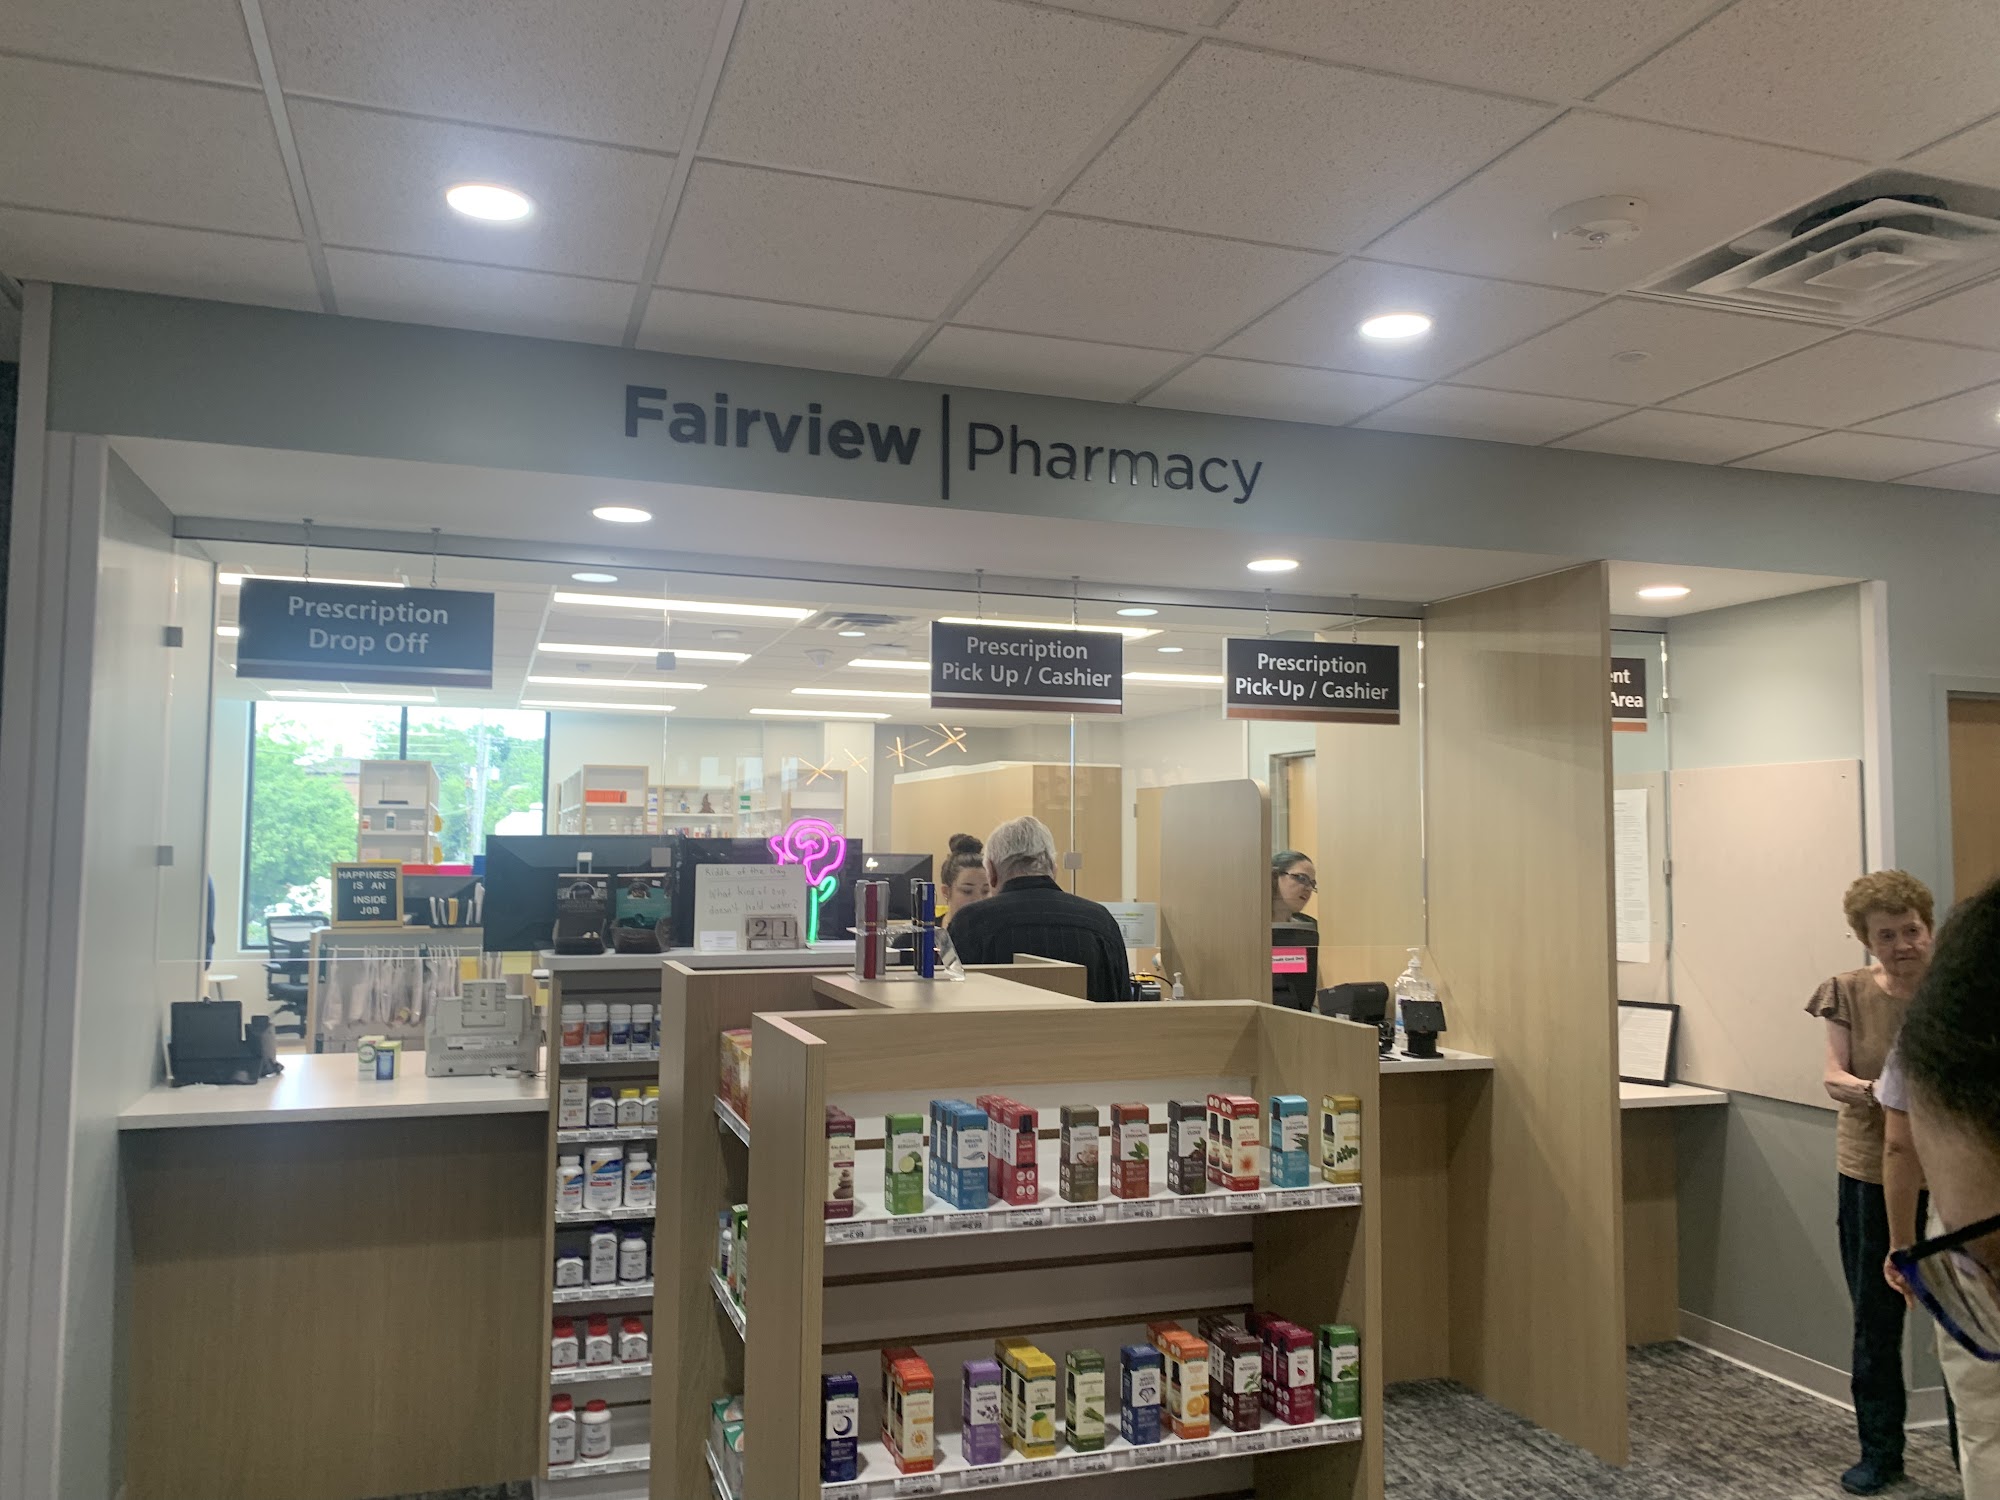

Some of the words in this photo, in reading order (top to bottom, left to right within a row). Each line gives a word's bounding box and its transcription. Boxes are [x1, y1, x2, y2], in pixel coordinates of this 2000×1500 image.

[624, 384, 921, 466] Fairview
[968, 421, 1263, 504] Pharmacy
[288, 596, 448, 626] Prescription
[309, 628, 376, 656] Drop
[385, 632, 429, 654] Off
[967, 636, 1088, 662] Prescription
[1257, 652, 1367, 677] Prescription
[942, 662, 984, 682] Pick
[990, 665, 1019, 687] Up
[1024, 666, 1033, 686] /
[1038, 667, 1112, 687] Cashier
[1235, 677, 1305, 701] Pick-Up
[1309, 680, 1317, 699] /
[1322, 681, 1389, 700] Cashier
[1610, 691, 1644, 708] Area
[338, 871, 397, 880] HAPPINESS
[705, 868, 730, 876] Riddle
[737, 867, 745, 875] of
[750, 867, 763, 875] the
[770, 866, 786, 878] Day
[352, 881, 364, 890] IS
[371, 881, 386, 890] AN
[709, 887, 731, 899] What
[737, 885, 755, 896] kind
[758, 886, 767, 895] of
[353, 895, 388, 904] INSIDE
[709, 902, 738, 914] doesn't
[745, 900, 764, 911] hold
[770, 898, 799, 910] water?
[360, 906, 380, 915] JOB
